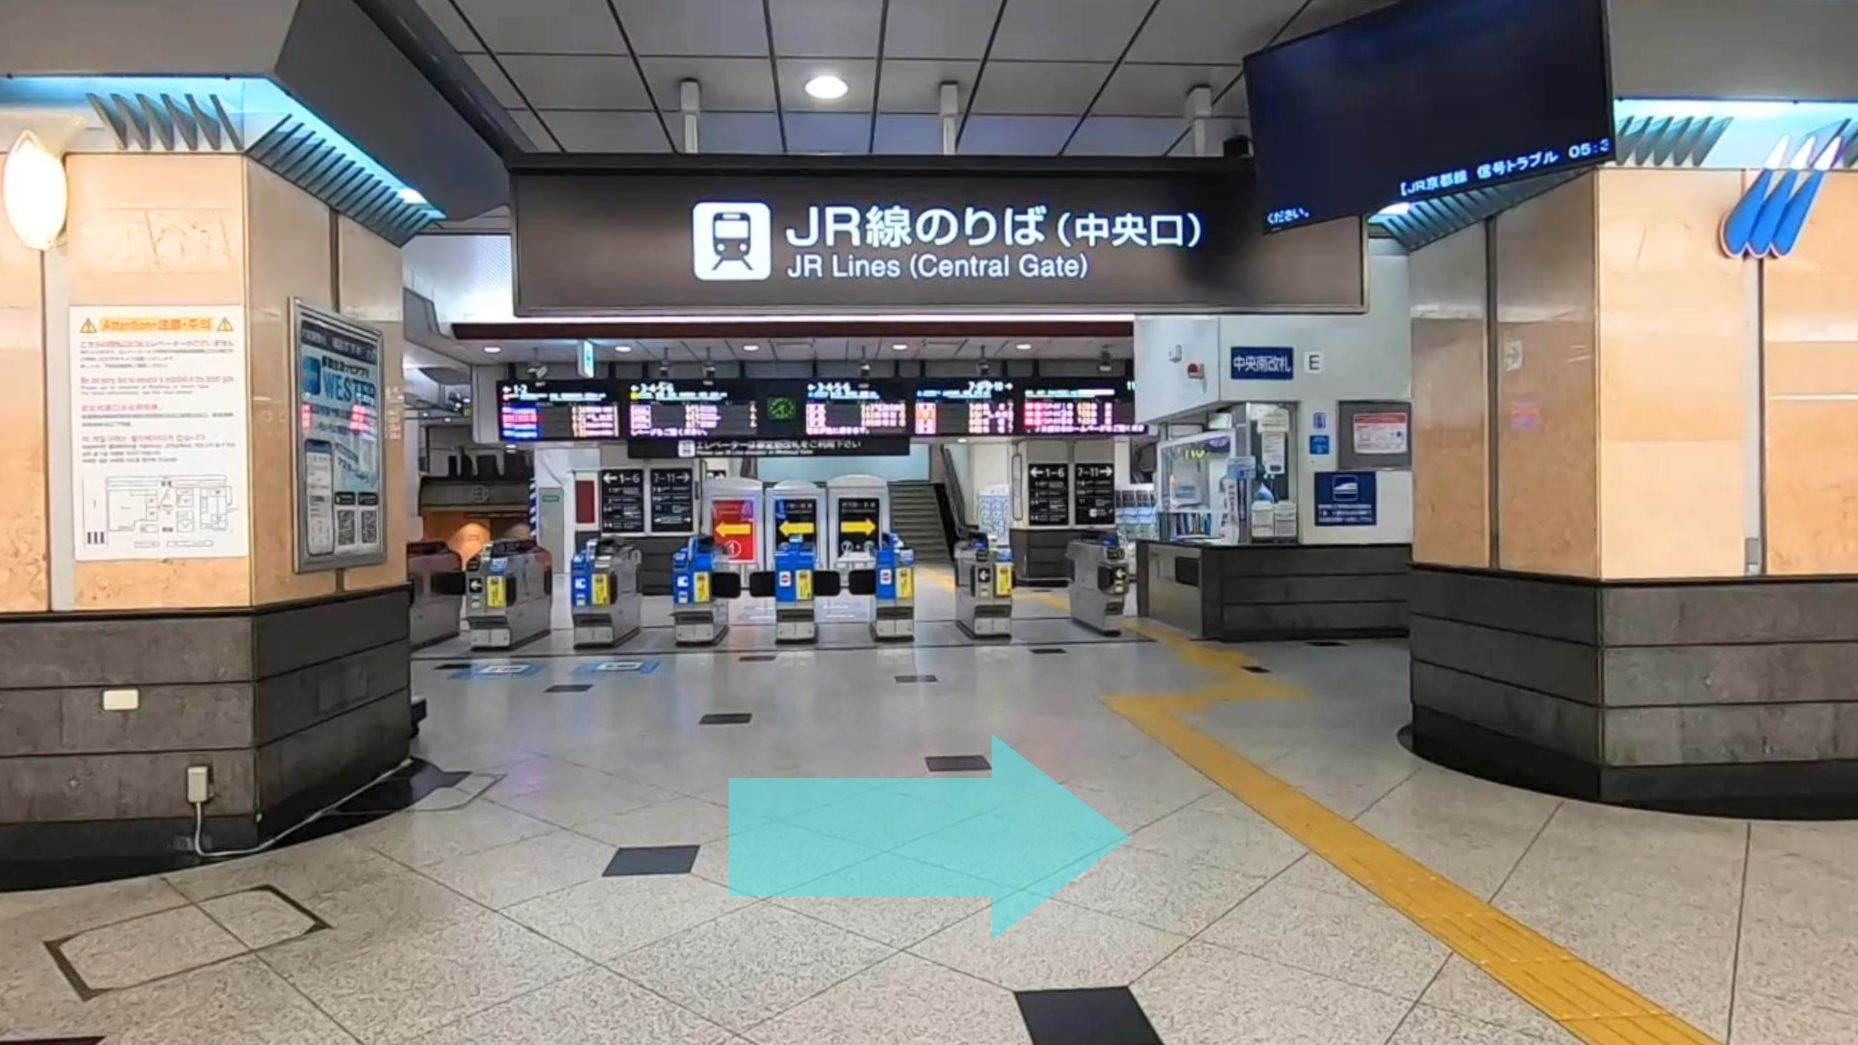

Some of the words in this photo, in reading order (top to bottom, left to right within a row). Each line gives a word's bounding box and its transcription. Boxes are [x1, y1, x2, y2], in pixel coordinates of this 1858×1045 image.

[1476, 151, 1559, 179] 信号トラブル
[787, 253, 823, 278] JR
[832, 253, 901, 278] Lines
[910, 252, 1010, 280] (Central
[1018, 252, 1088, 280] Gate)
[1233, 355, 1291, 373] 中央南改札
[1309, 354, 1320, 371] E
